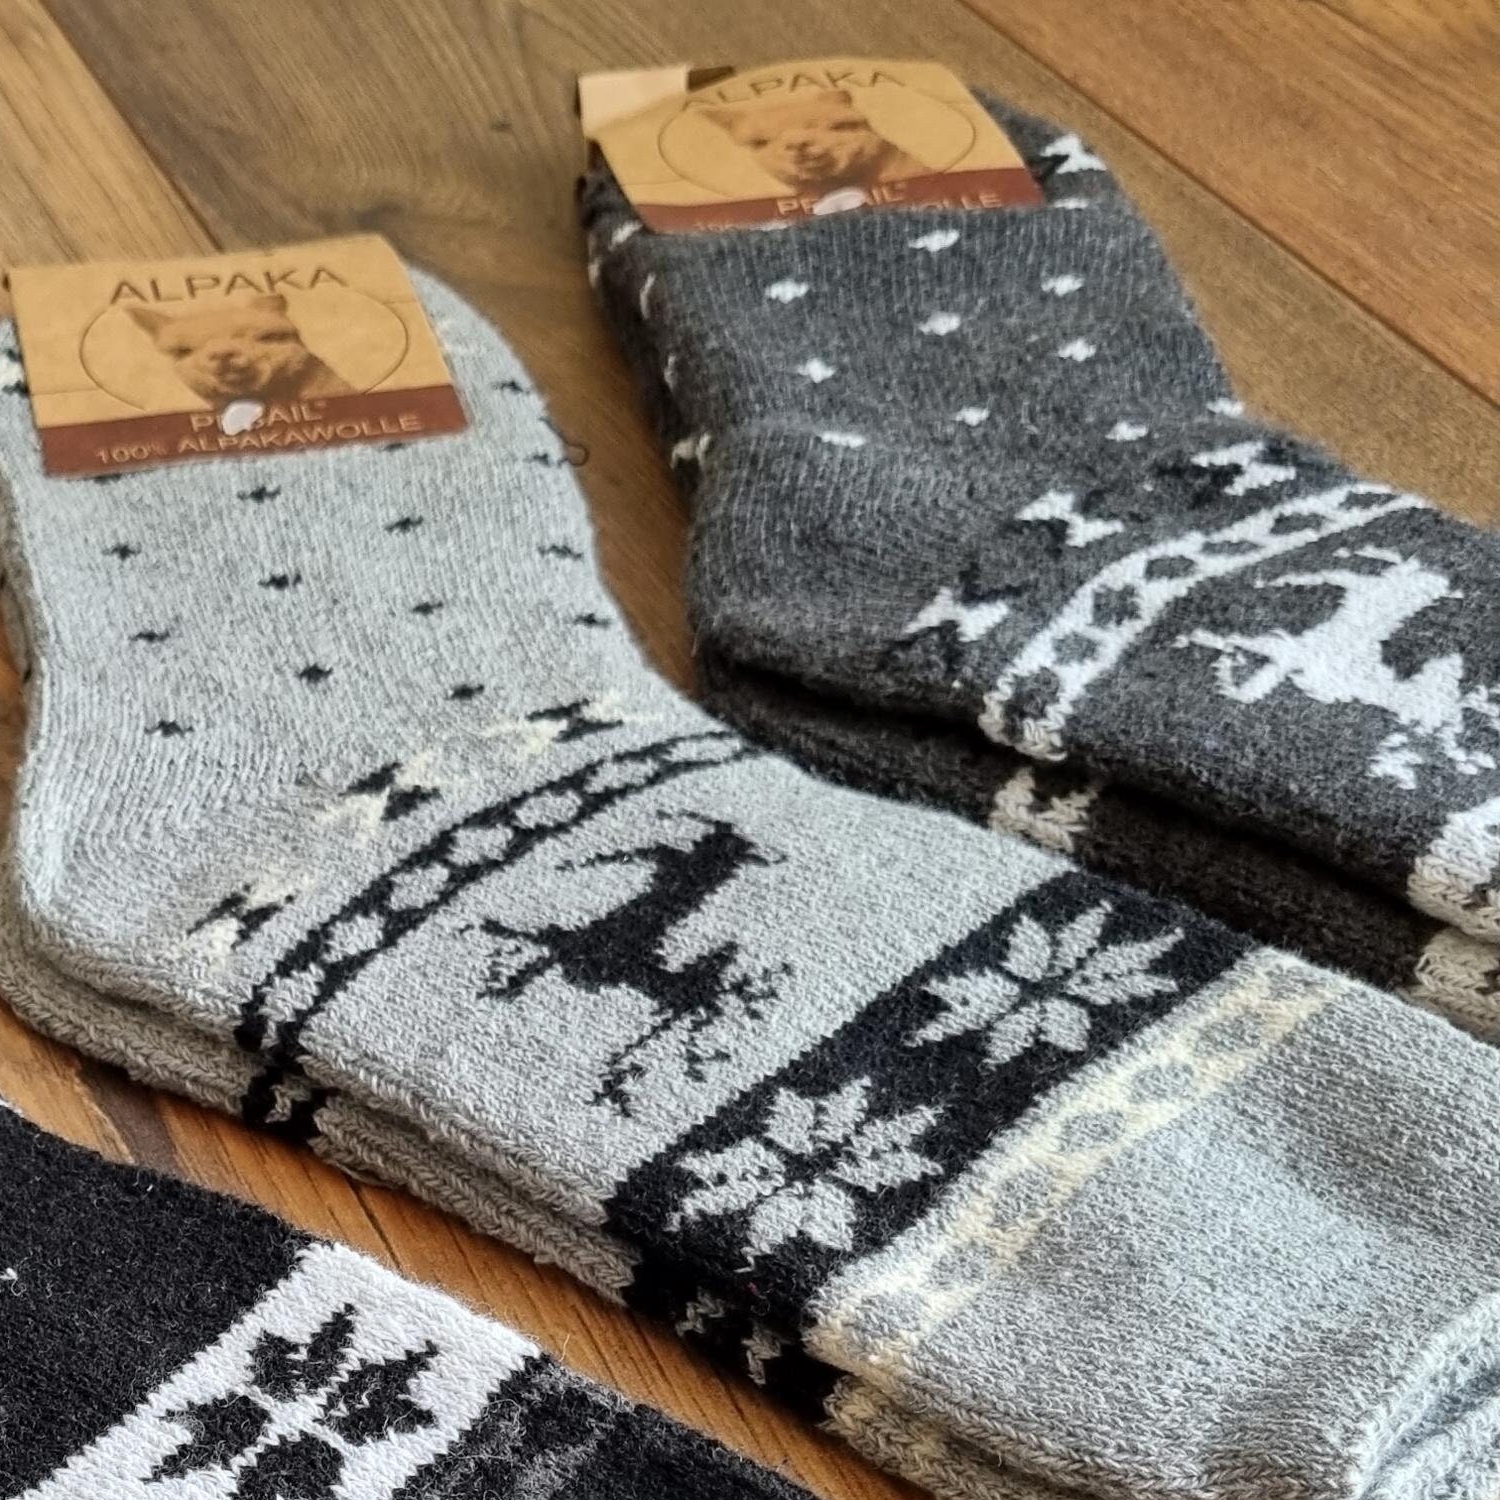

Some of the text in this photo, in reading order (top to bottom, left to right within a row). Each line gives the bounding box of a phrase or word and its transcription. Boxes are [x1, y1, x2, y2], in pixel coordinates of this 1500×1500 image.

[680, 70, 906, 112] ALPAKA
[109, 263, 349, 306] ALPAKA
[95, 414, 422, 466] 100% ALPAKAWOLLE
